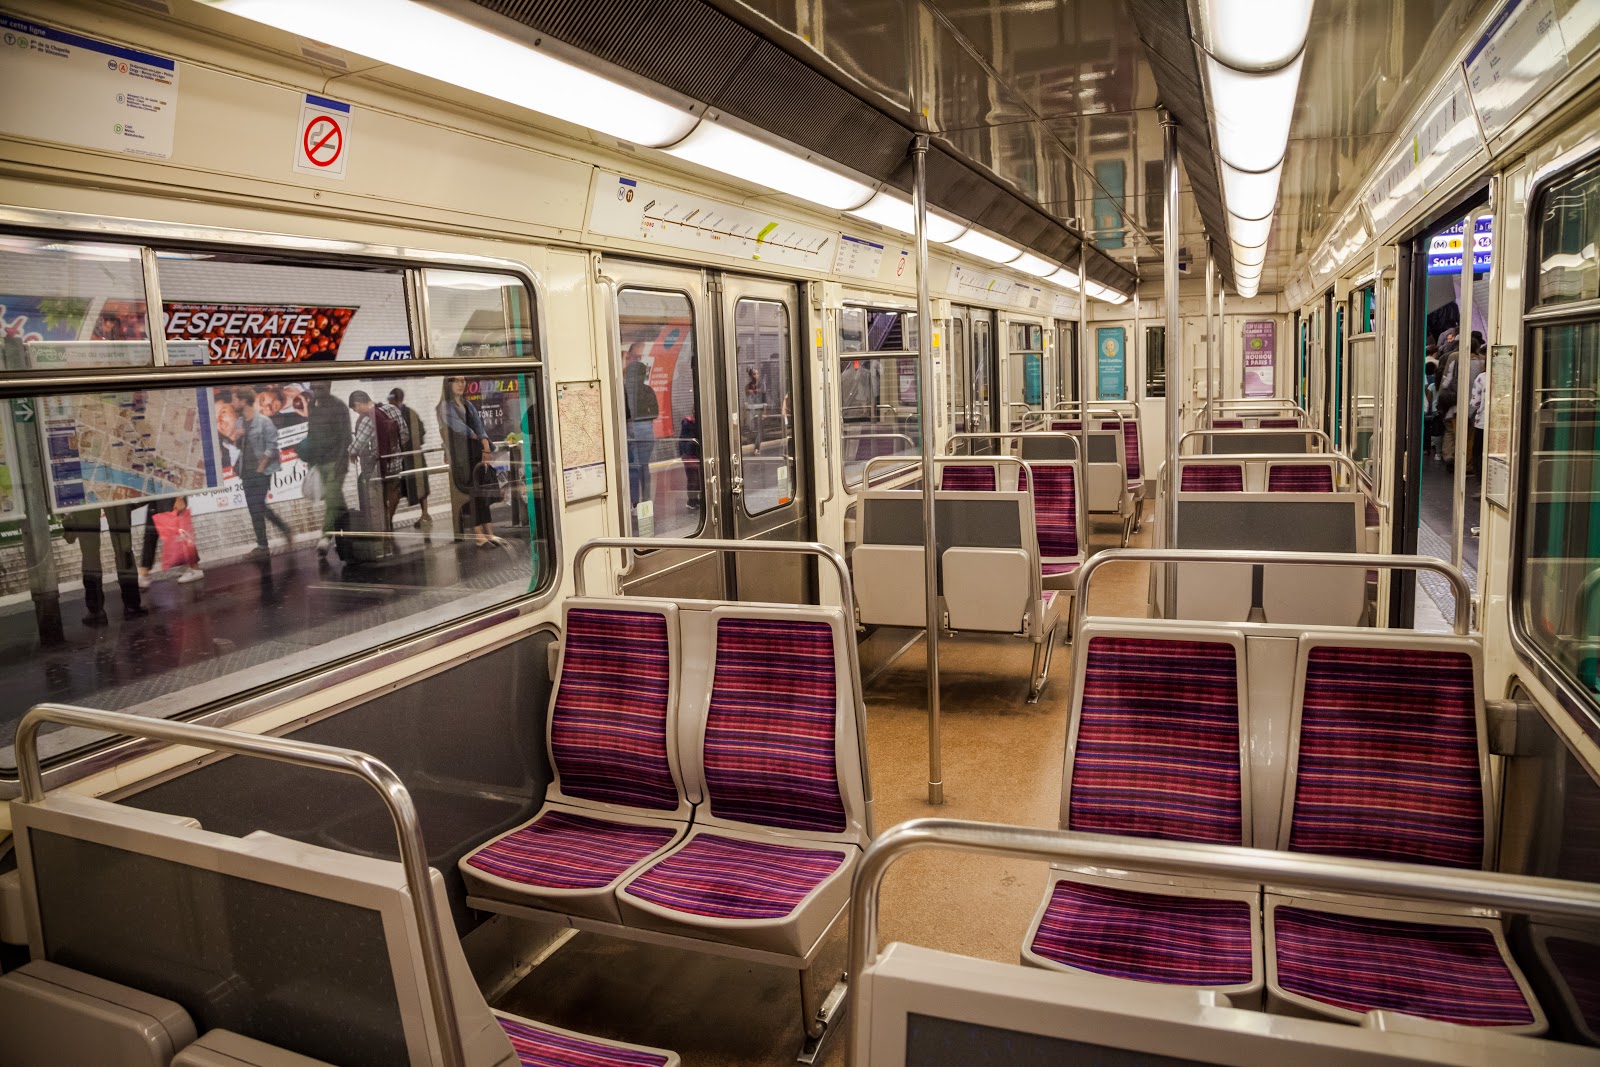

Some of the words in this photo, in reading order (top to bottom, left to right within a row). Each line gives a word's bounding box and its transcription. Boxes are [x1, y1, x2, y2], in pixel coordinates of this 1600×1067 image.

[1479, 239, 1491, 247] 14
[1433, 256, 1463, 267] Sortie
[370, 348, 412, 360] CHÂTE
